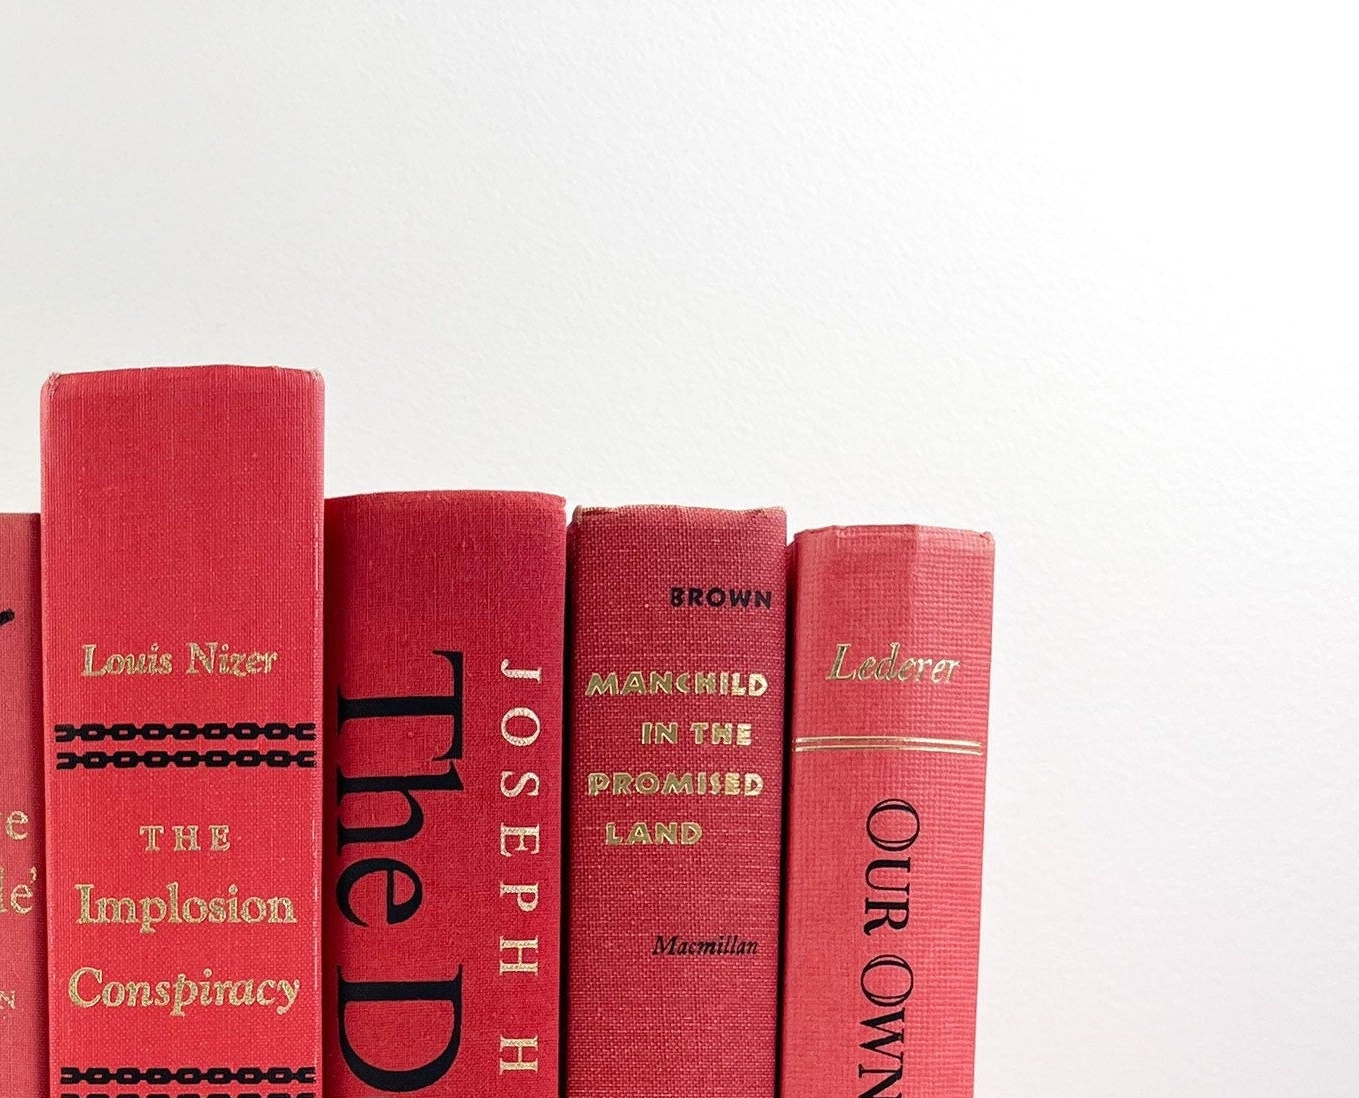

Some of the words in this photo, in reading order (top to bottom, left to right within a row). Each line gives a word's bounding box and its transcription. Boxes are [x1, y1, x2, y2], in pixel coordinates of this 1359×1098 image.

[670, 587, 772, 608] BROWN
[81, 643, 173, 676] Louis
[186, 643, 279, 674] Nizer
[826, 643, 960, 684] Lederer
[585, 672, 769, 697] MANCHILD
[641, 723, 678, 746] IN
[691, 722, 753, 746] THE
[336, 650, 465, 928] The
[588, 772, 765, 797] PROMISED
[499, 659, 542, 976] JOSEPH
[139, 824, 232, 852] THE
[605, 822, 703, 846] LAND
[863, 799, 921, 936] OUR
[74, 882, 298, 933] Implosion
[651, 935, 759, 957] Macmillan
[68, 967, 301, 1017] Conspiracy
